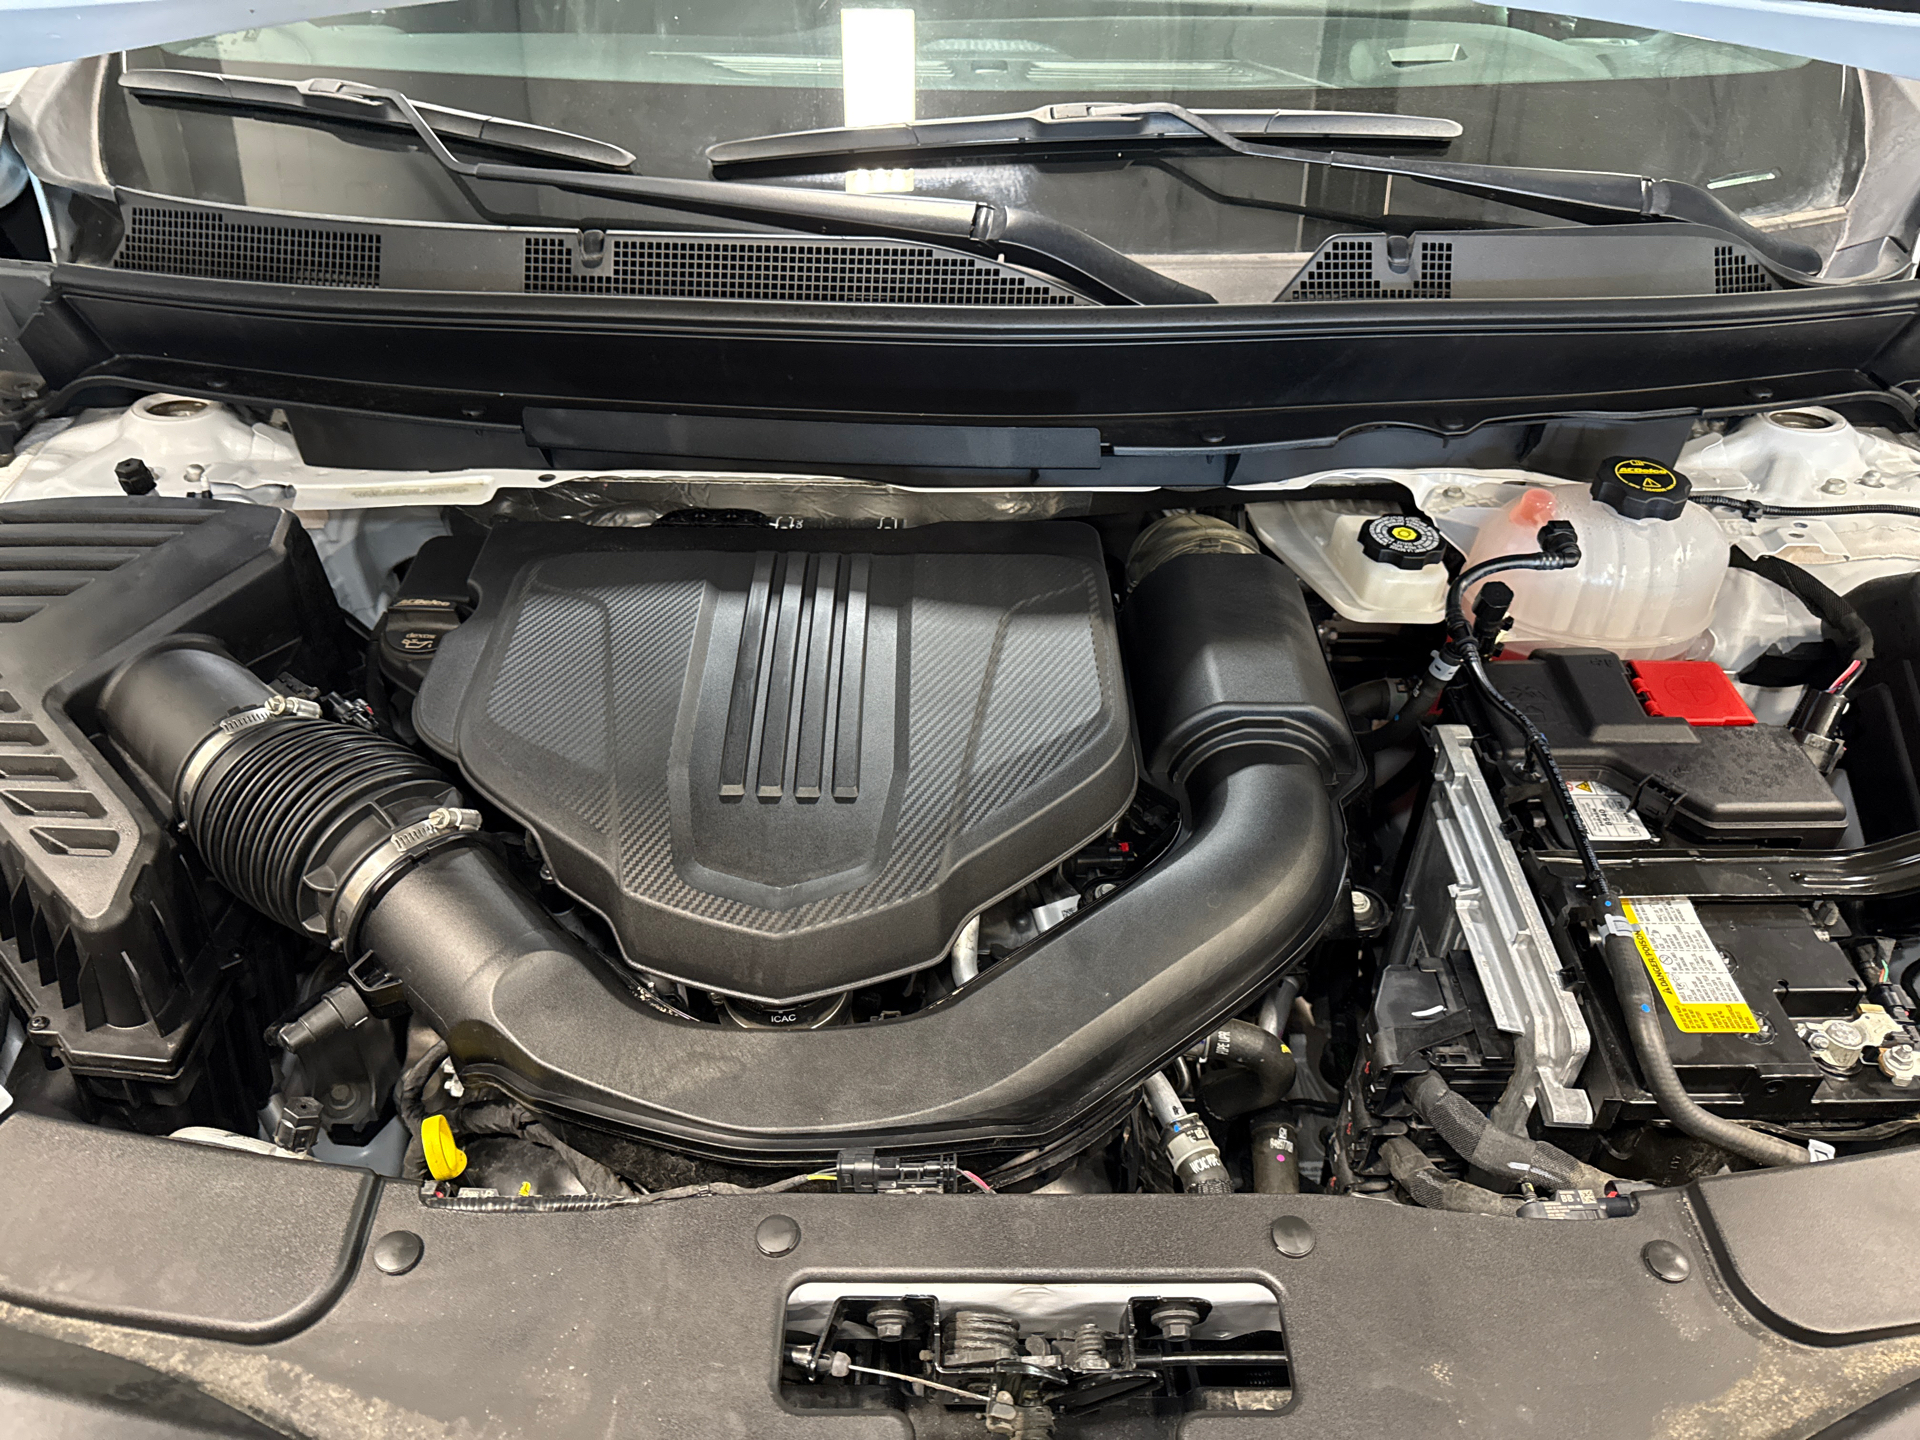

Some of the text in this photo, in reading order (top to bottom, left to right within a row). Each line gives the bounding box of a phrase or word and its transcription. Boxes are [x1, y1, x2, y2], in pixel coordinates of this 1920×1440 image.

[1634, 931, 1669, 987] DANGER POISON
[770, 1013, 797, 1023] ICAC
